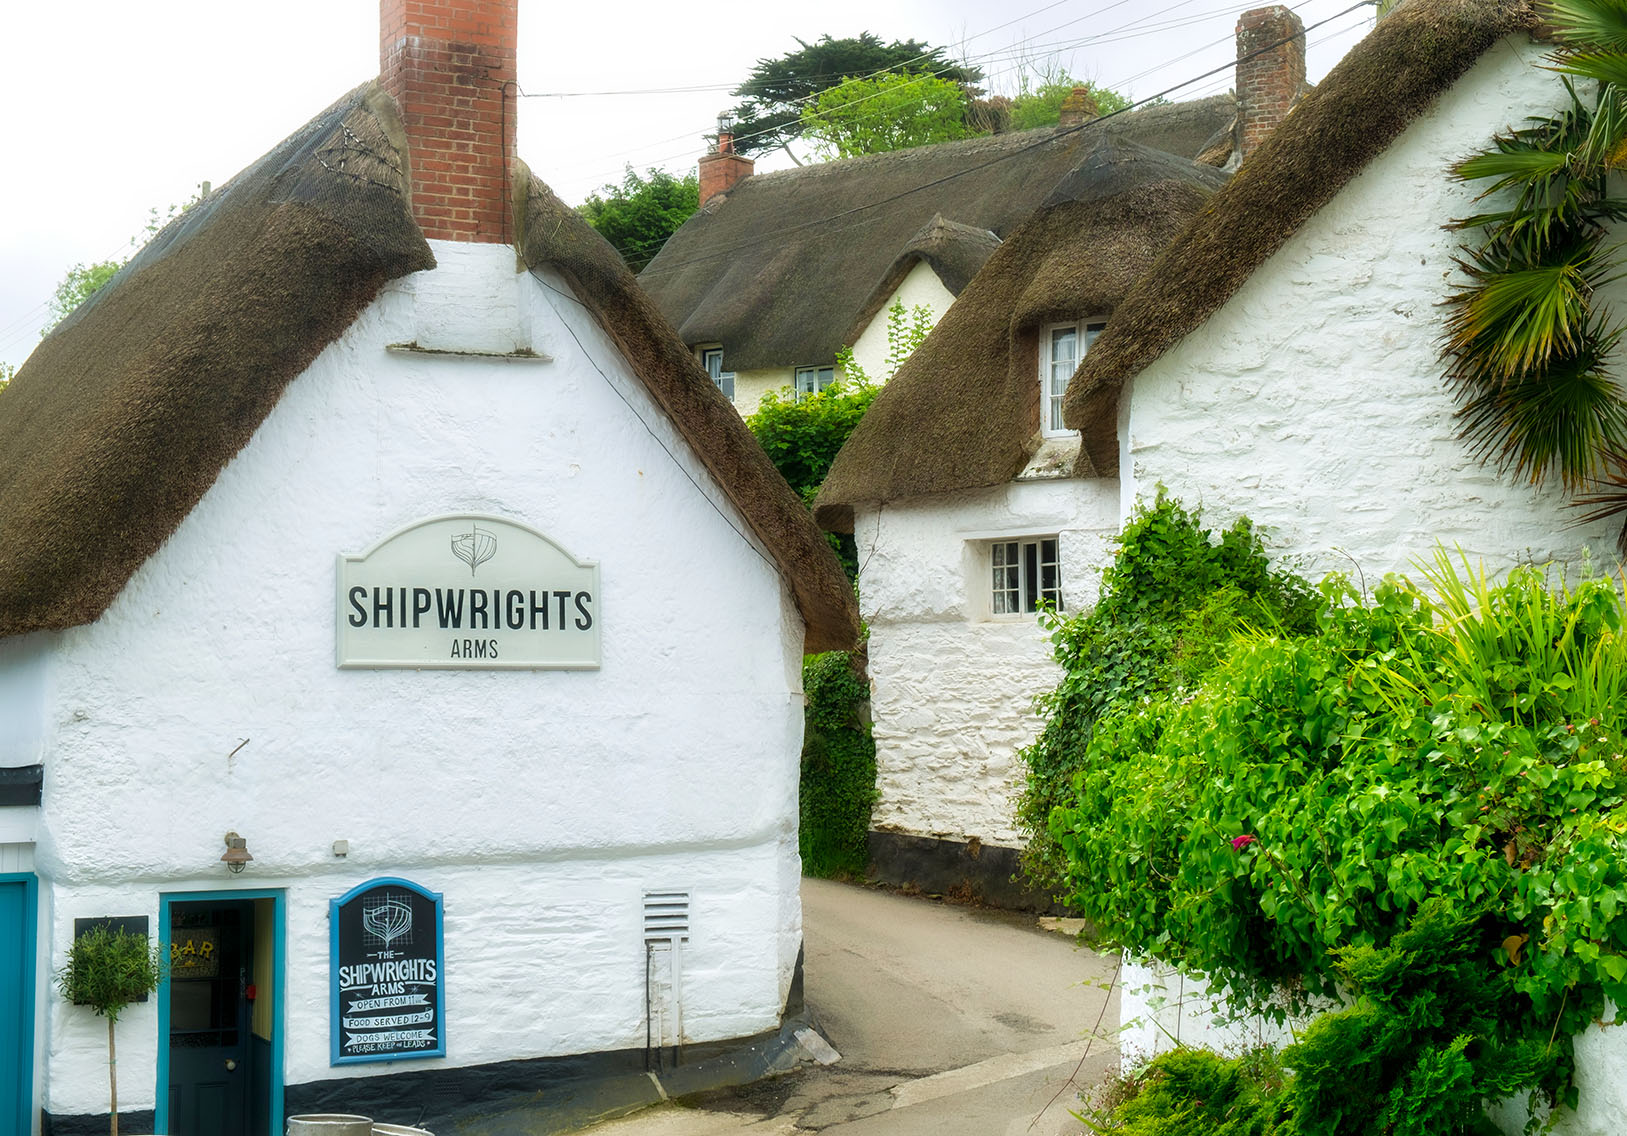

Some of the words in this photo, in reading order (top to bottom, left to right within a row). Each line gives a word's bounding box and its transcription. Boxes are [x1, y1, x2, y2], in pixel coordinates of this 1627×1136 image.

[349, 586, 592, 631] SHIPWRIGHTS
[450, 639, 498, 658] ARMS
[171, 940, 214, 959] BAR
[377, 950, 395, 959] THE
[339, 959, 437, 987] SHIPWRIGHTS
[371, 982, 405, 996] ARMS
[357, 1000, 381, 1010] OPEN
[383, 996, 407, 1008] FROM
[348, 1018, 371, 1028] FOOD
[373, 1015, 409, 1026] SERVED
[411, 1012, 431, 1024] 12-9
[356, 1034, 380, 1043] DOGS
[383, 1030, 423, 1041] WELCOME
[352, 1043, 376, 1054] PLEASE
[377, 1041, 395, 1052] KEEP
[403, 1040, 426, 1049] LEADS
